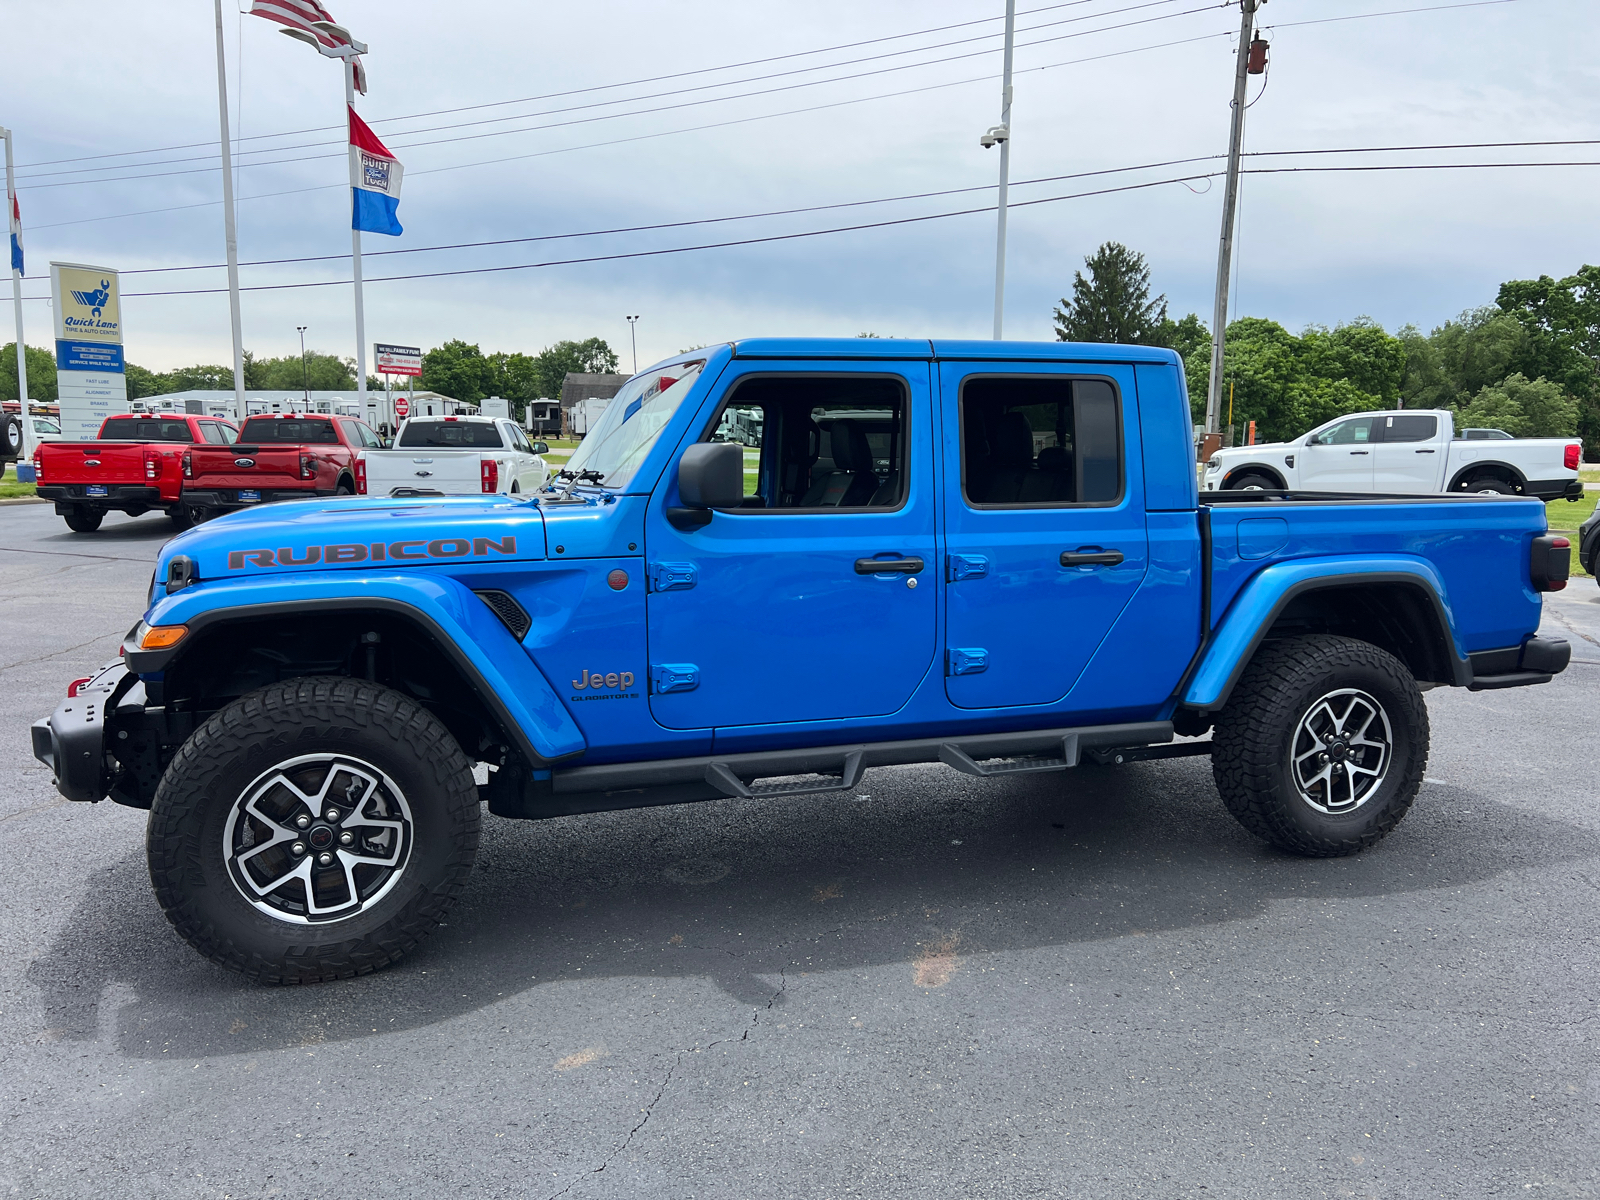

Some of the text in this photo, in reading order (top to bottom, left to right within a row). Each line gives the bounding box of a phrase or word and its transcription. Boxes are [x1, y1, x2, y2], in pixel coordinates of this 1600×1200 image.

[362, 155, 389, 171] BUILT
[65, 316, 118, 329] Quick Lane
[228, 536, 517, 570] RUBICON
[572, 669, 635, 691] Jeep
[571, 693, 629, 702] GLADIATOR
